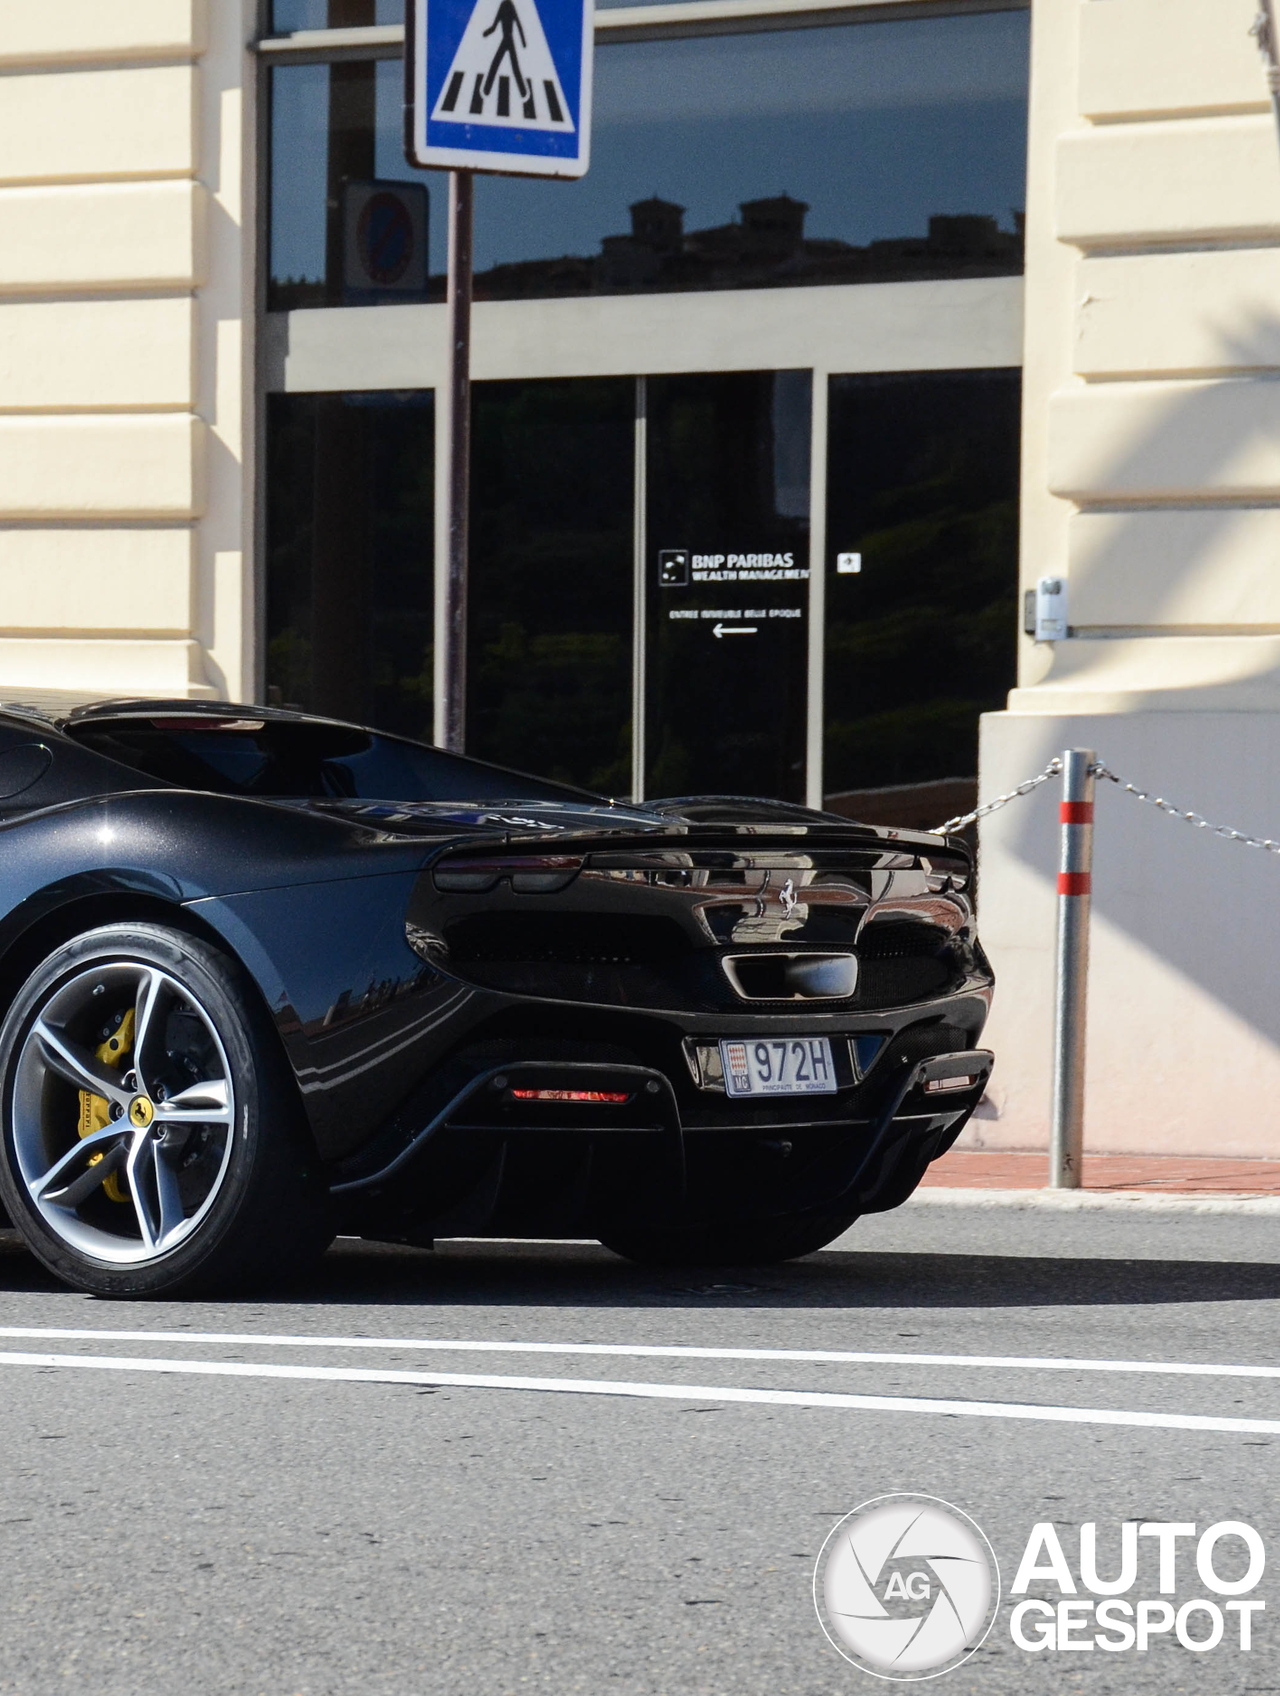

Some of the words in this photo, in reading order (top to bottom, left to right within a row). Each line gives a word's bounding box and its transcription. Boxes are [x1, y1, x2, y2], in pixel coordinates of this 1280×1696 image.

[691, 554, 725, 569] BNP
[726, 552, 794, 568] PARIBAS
[691, 570, 737, 581] WEALTH
[738, 569, 810, 580] MANAGEMEN
[755, 1041, 828, 1082] 972H
[735, 1076, 748, 1089] MC
